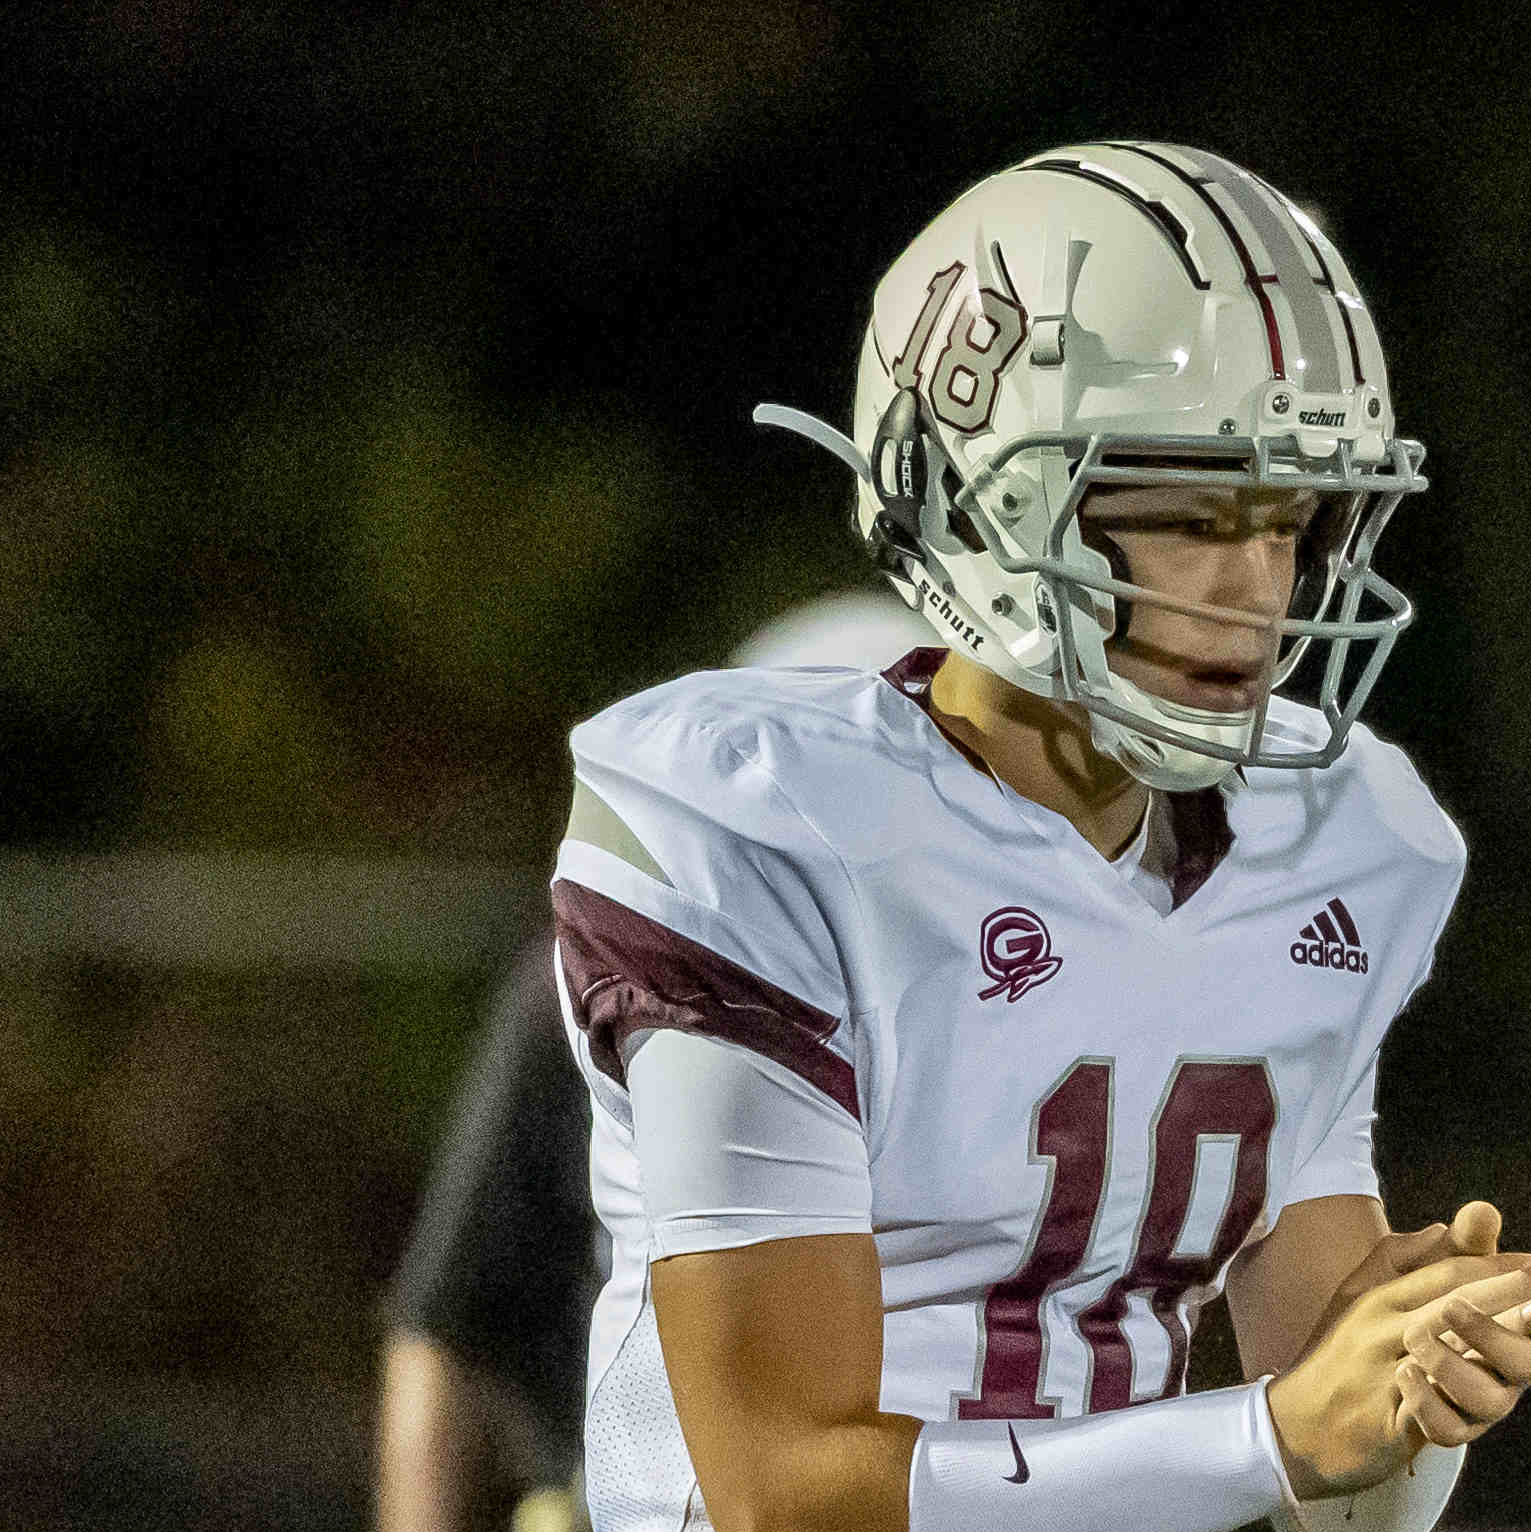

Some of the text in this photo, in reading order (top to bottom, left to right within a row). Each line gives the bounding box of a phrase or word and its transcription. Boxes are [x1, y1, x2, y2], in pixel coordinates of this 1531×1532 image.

[892, 260, 1029, 434] 18
[1298, 407, 1346, 427] schutt
[902, 440, 914, 498] SHOCK
[918, 579, 984, 651] schutt
[1289, 940, 1369, 975] adidas
